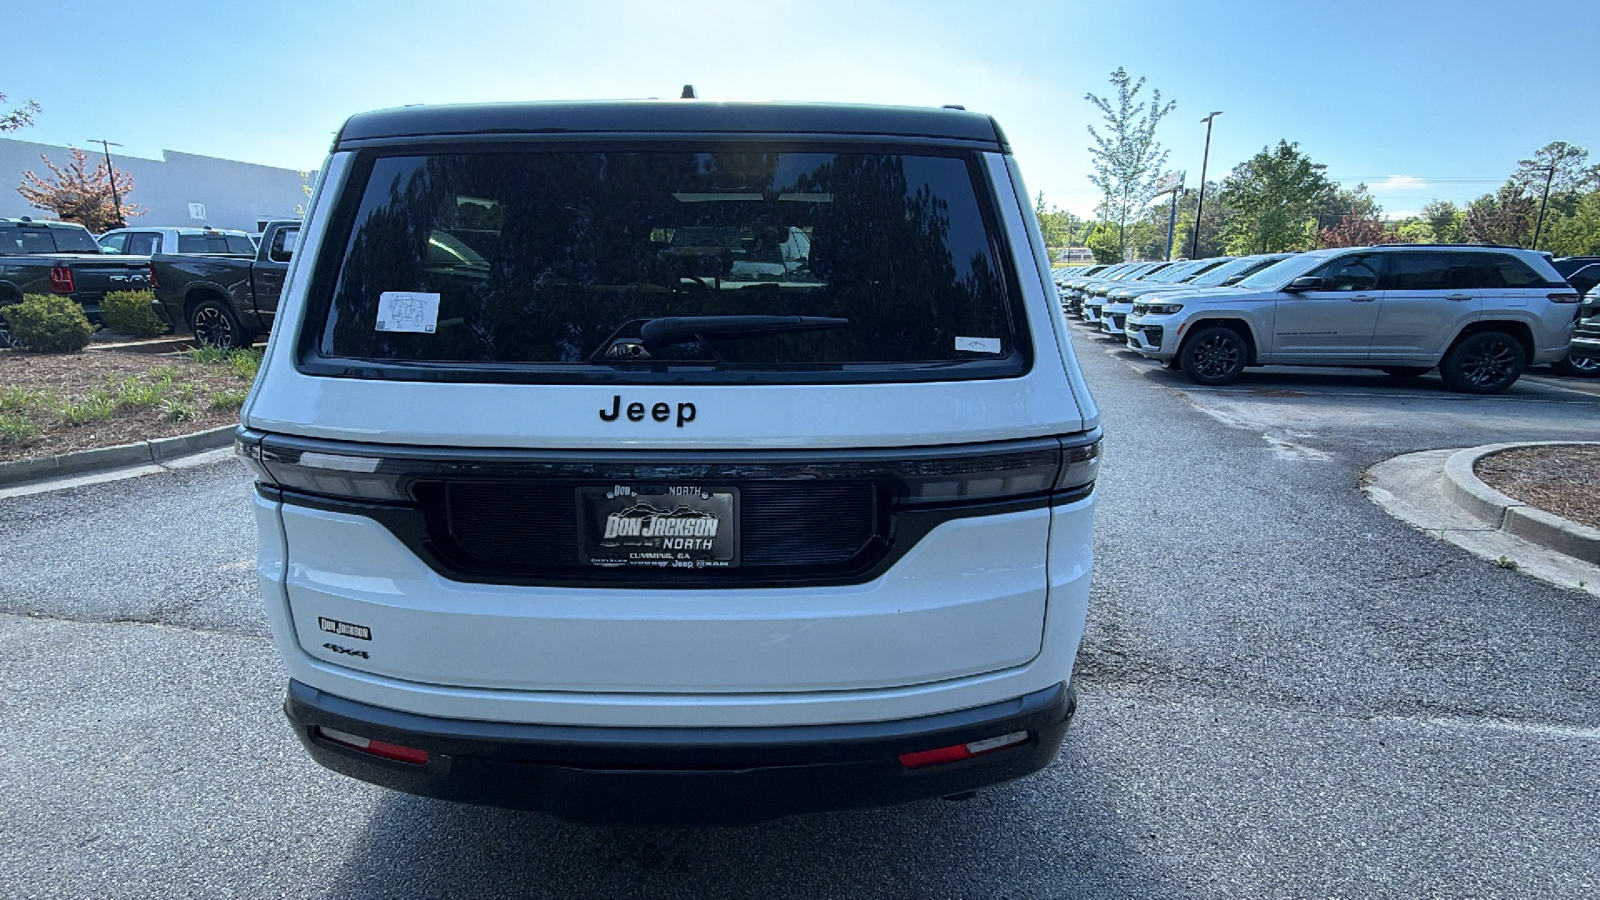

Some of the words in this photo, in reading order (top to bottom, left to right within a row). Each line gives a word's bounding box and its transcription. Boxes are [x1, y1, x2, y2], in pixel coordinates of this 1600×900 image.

[599, 395, 697, 428] Jeep
[669, 486, 702, 496] NORTH
[603, 516, 642, 539] DON
[641, 517, 719, 538] JACKSON
[662, 538, 713, 550] NORTH
[671, 560, 694, 569] Jeep
[321, 618, 336, 632] DON
[336, 622, 369, 639] JACKSON
